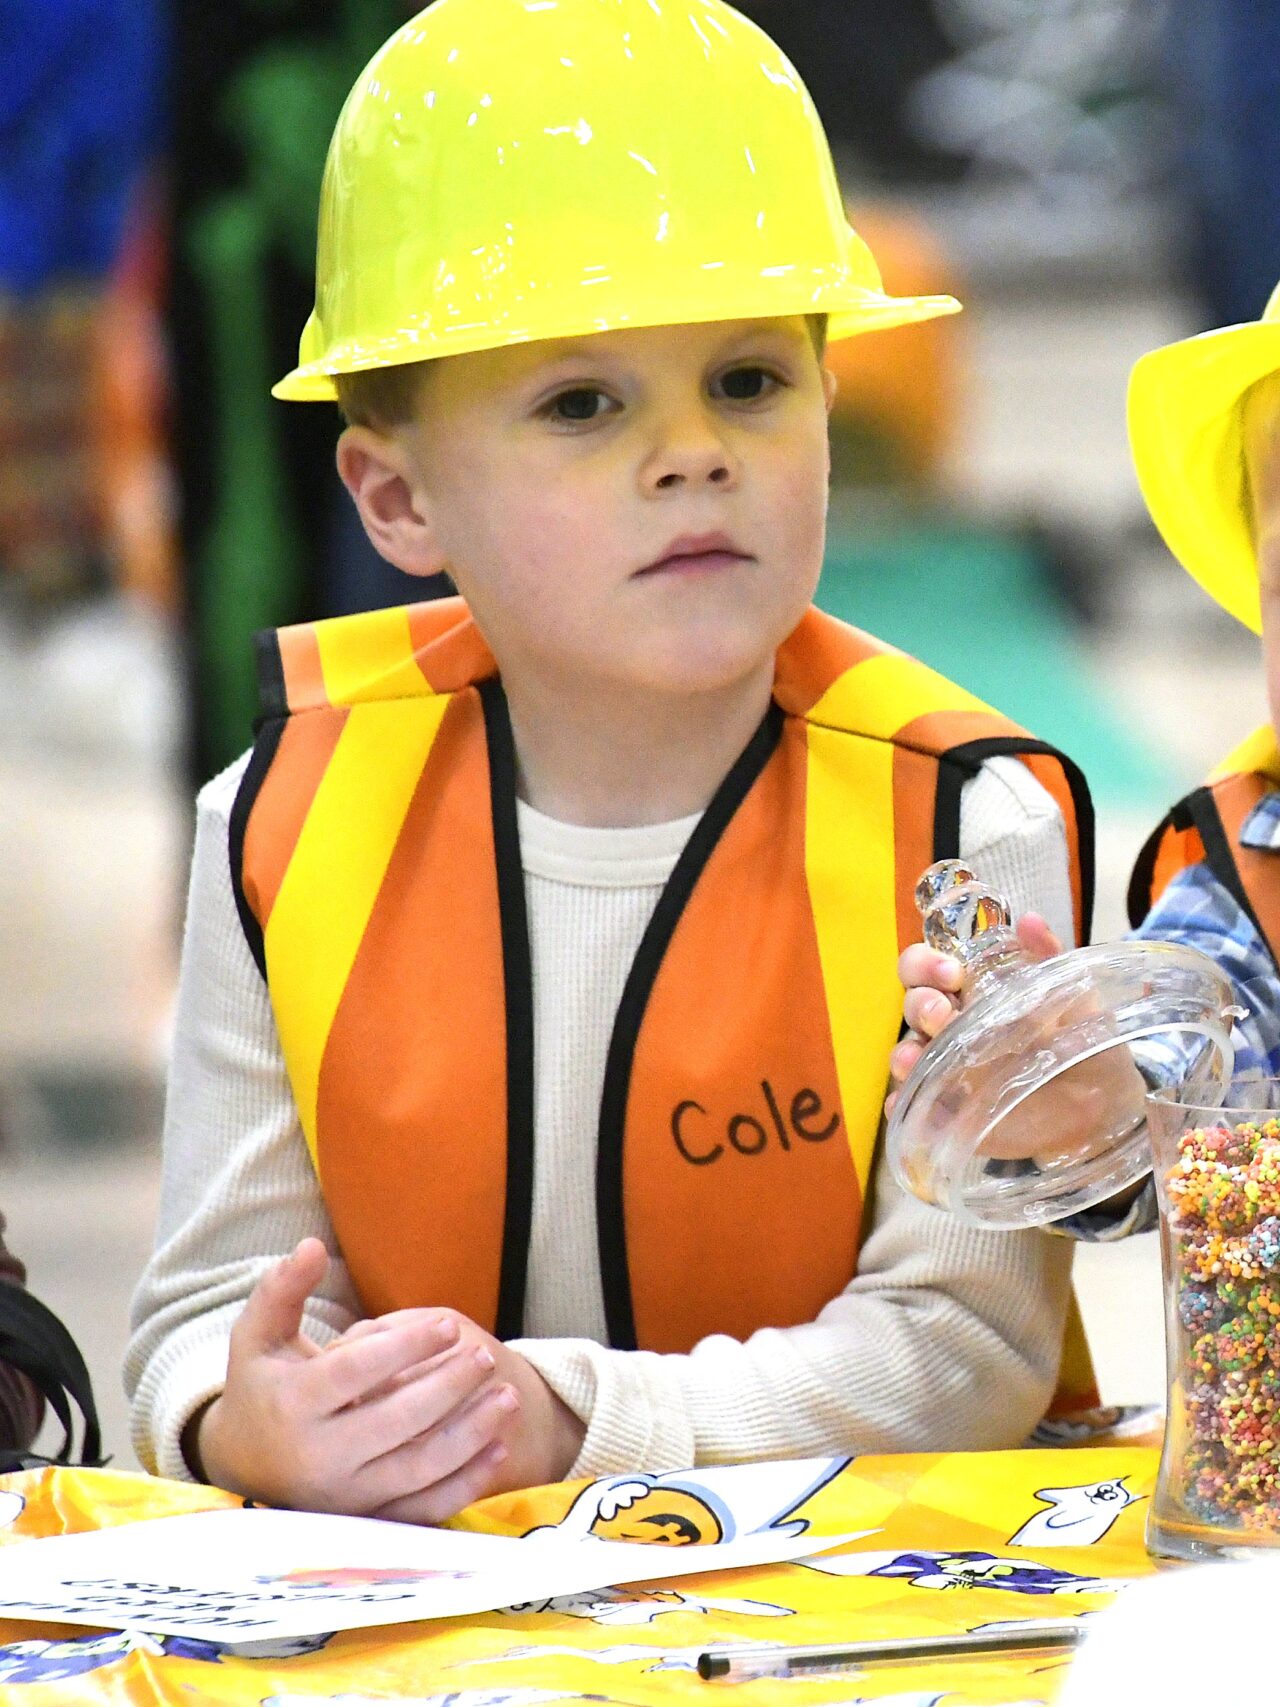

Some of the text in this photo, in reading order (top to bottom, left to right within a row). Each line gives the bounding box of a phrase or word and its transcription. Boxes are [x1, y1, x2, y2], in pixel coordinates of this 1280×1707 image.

[671, 1078, 840, 1166] Cole
[0, 1601, 277, 1628] HOW MA
[75, 1595, 256, 1612] NERD
